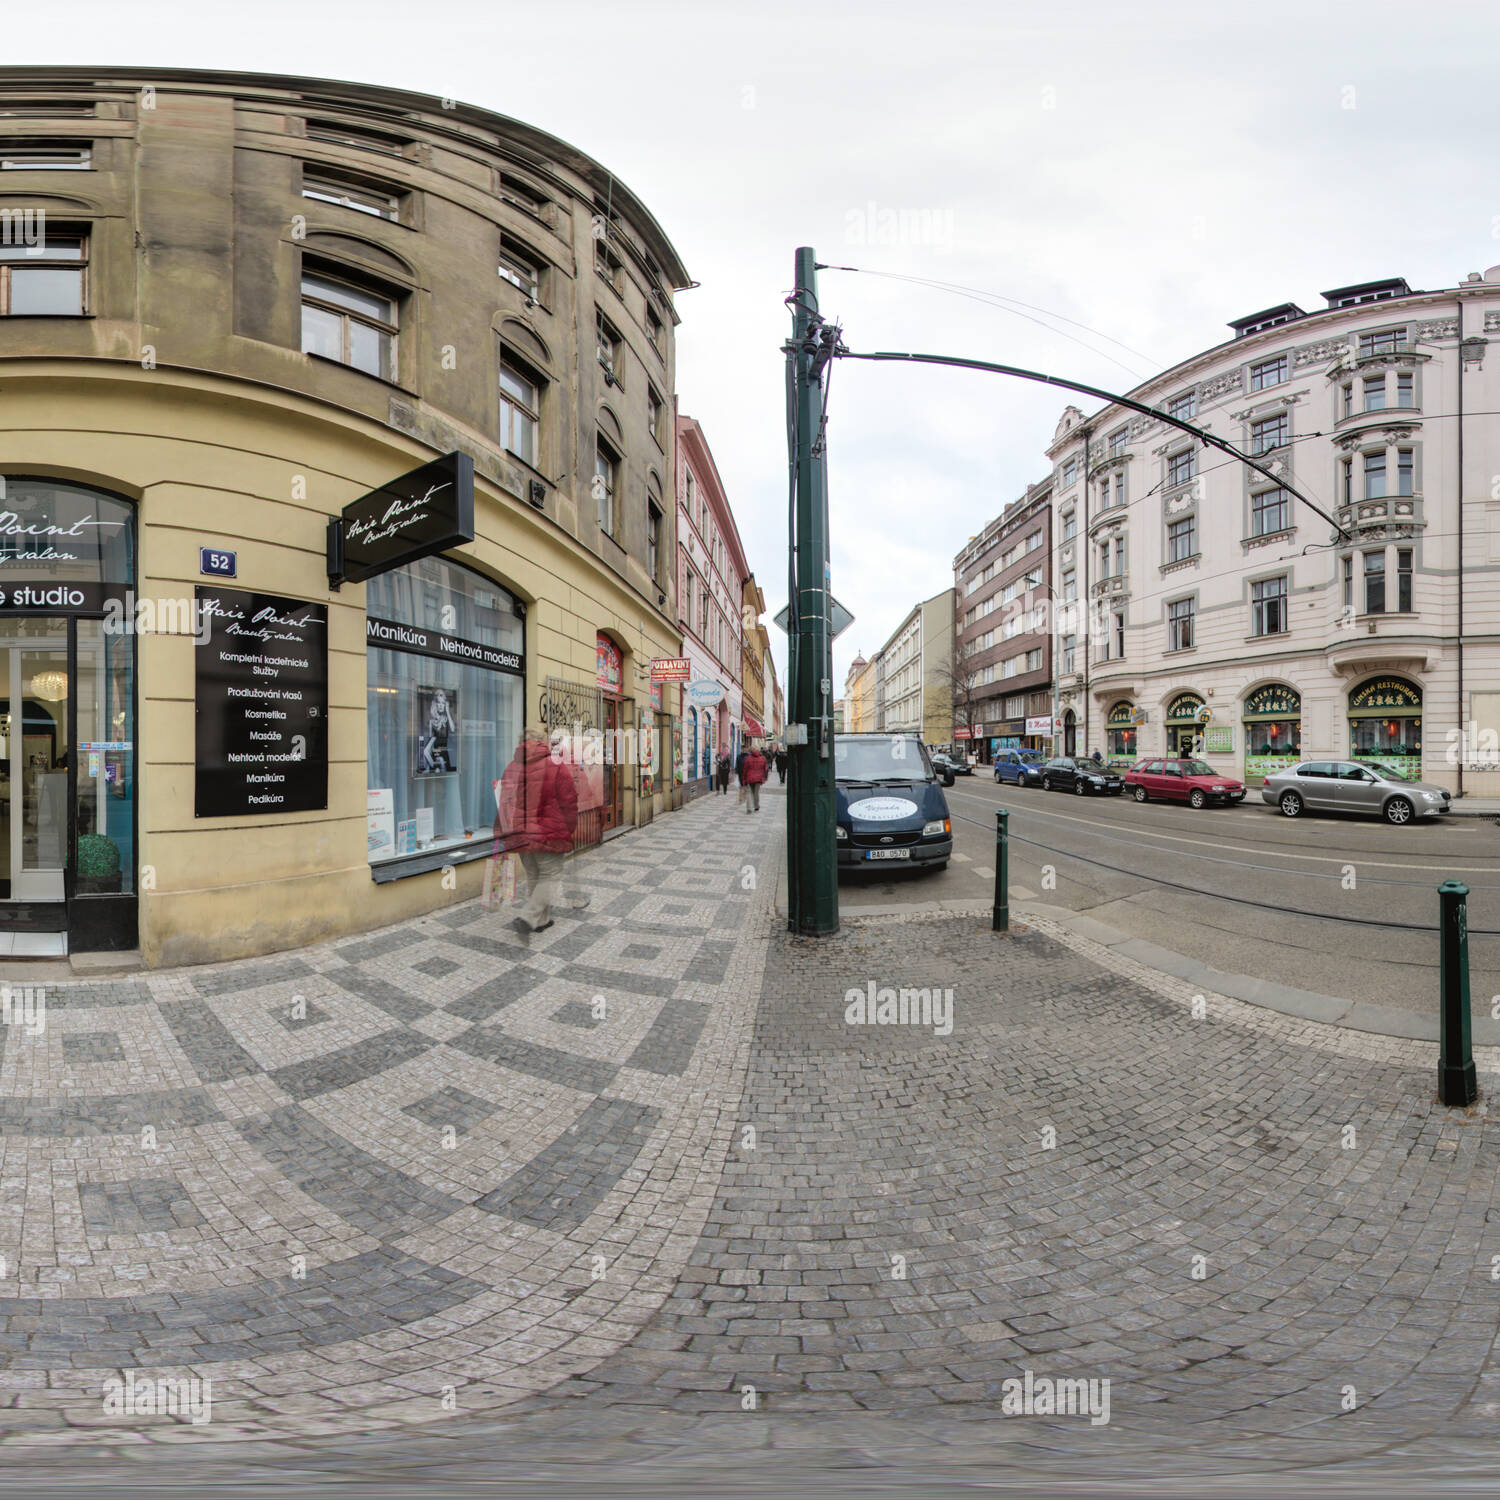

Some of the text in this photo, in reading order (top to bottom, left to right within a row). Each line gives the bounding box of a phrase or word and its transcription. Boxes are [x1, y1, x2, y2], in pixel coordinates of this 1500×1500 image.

[346, 482, 452, 539] Hair Point
[362, 513, 428, 545] Beauty salon
[17, 546, 78, 560] salon
[210, 554, 229, 570] 52
[13, 587, 84, 606] studio
[200, 599, 325, 628] Hair Point
[225, 622, 304, 642] Beauty salon
[367, 620, 519, 668] Manikúra Nehtová modeláž
[220, 651, 262, 664] Kompletní
[651, 660, 689, 669] POTRAVINY
[253, 666, 279, 677] Služby
[228, 687, 281, 699] Prodlužování
[245, 709, 286, 720] Kosmetika
[250, 731, 282, 741] Masáže
[228, 753, 264, 762] Nehtová
[246, 773, 285, 783] Manikúra
[248, 794, 284, 804] Pedikúra
